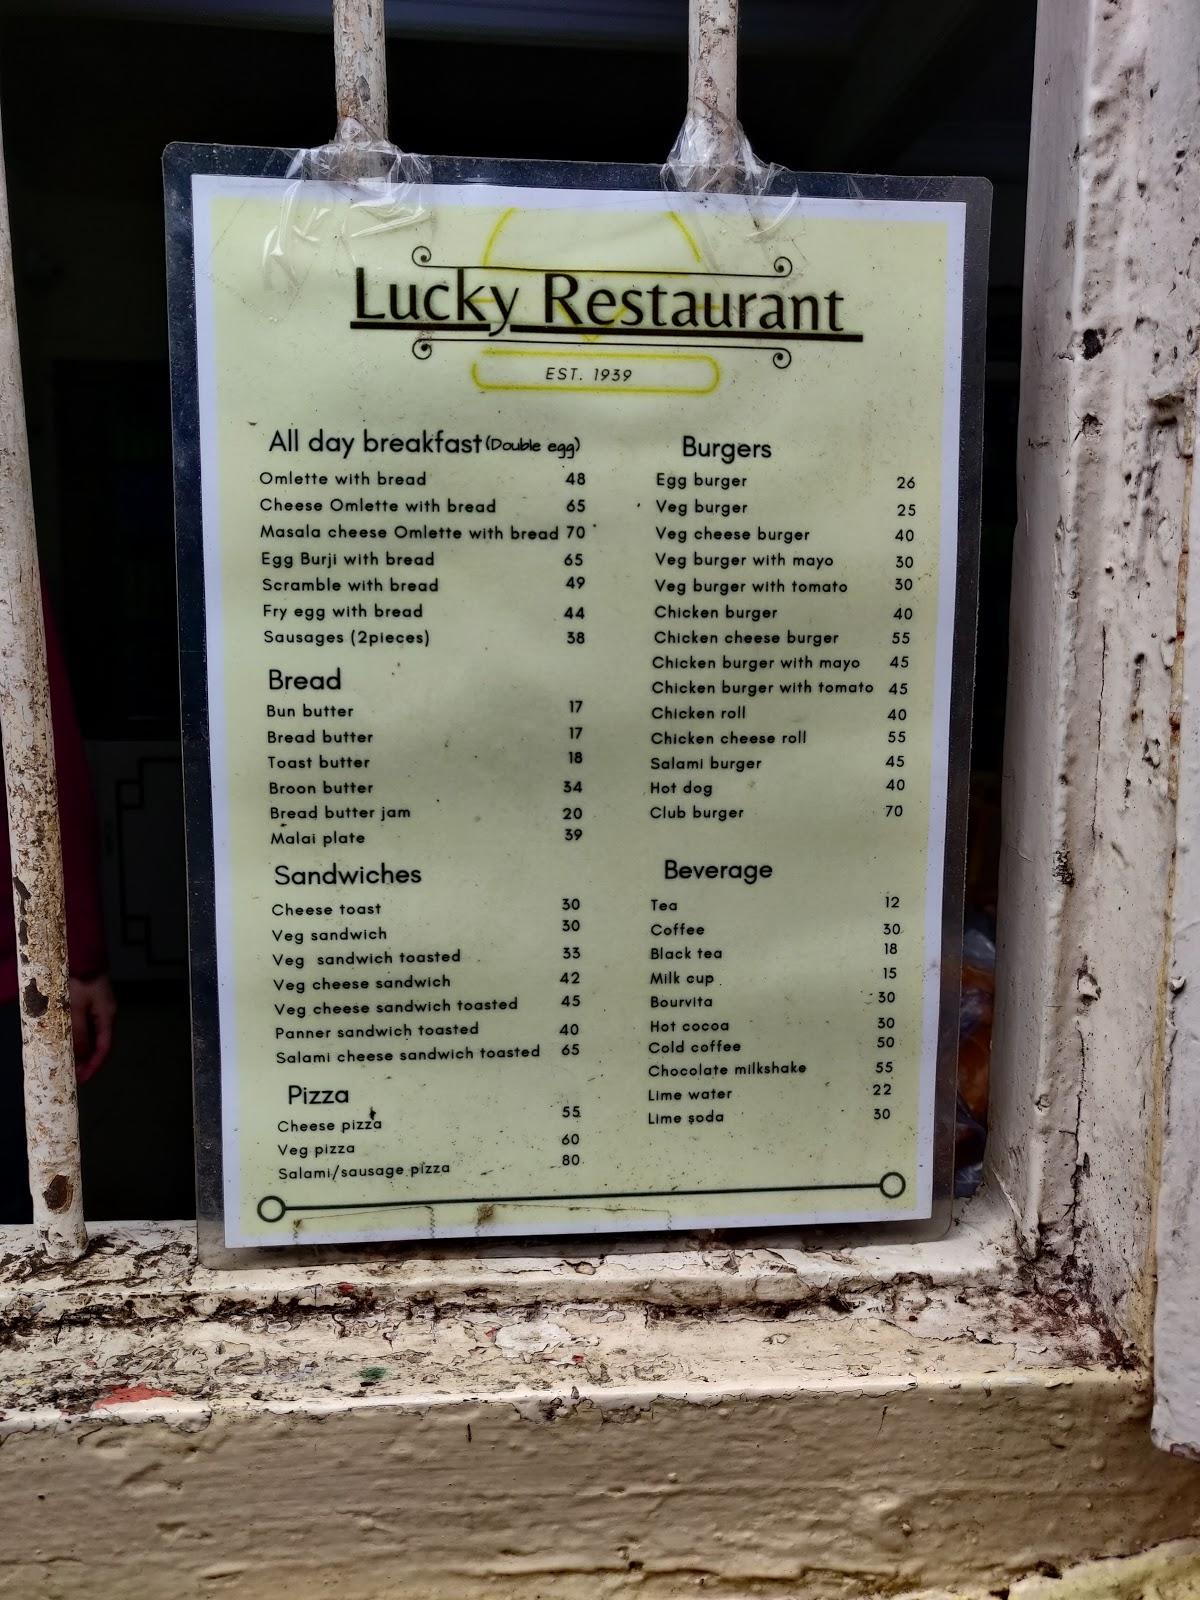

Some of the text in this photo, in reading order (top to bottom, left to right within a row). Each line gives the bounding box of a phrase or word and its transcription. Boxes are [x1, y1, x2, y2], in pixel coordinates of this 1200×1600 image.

[355, 266, 846, 336] Lucky Restaurant
[545, 367, 633, 382] EST. 1939
[268, 427, 581, 460] All day breakfast (Double egg)
[682, 434, 773, 465] Burgers
[259, 470, 586, 487] Omlette with bread 48
[655, 471, 916, 491] Egg burger 26
[655, 498, 917, 518] Veg burger 25
[260, 523, 586, 541] Masala cheese Omlette with bread 70
[655, 525, 915, 545] Veg cheese burger 40
[261, 550, 584, 570] Egg Burji with bread 65
[654, 577, 913, 597] Veg burger with tomato 30
[263, 602, 586, 622] Fry egg with bread 44
[654, 603, 913, 623] Chicken burger 40
[263, 628, 586, 648] Sausages (2pieces) 38
[651, 654, 910, 673] Chicken burger with mayo 45
[268, 666, 342, 691] Bread
[651, 679, 908, 698] Chicken burger with tomato 45
[266, 699, 584, 718] Bun butter 17
[650, 705, 907, 721] Chicken roll 40
[267, 726, 584, 744] Bread butter 17
[650, 729, 906, 745] Chicken cheese roll 55
[267, 751, 584, 769] Toast butter 18
[650, 755, 905, 773] Salami burger 45
[268, 780, 583, 795] Broon butter 34
[649, 778, 906, 798] Hot dog 40
[270, 804, 583, 822] Bread butter jam 20
[649, 804, 904, 823] Club burger 70
[270, 827, 583, 848] Malai plate 39
[274, 861, 423, 886] Sandwiches
[664, 858, 773, 886] Beverage
[271, 897, 581, 917] Cheese toast 30
[650, 895, 900, 912] Tea 12
[271, 919, 581, 945] Veg sandwich 30
[650, 922, 901, 937] Coffee 30
[272, 946, 581, 970] Veg sandwich toasted 33
[649, 942, 898, 961] Black tea 18
[649, 966, 897, 988] Milk cup 15
[273, 994, 581, 1019] Veg cheese sandwich toasted 45
[650, 991, 896, 1009] Bourvita 30
[650, 1016, 896, 1033] Hot cocoa 30
[276, 1043, 580, 1065] Salami cheese sandwich toasted 65
[648, 1036, 895, 1055] Cold coffee 50
[647, 1060, 894, 1078] Chocolate milkshake 55
[288, 1084, 350, 1105] Pizza
[648, 1082, 892, 1102] Lime water 22
[277, 1133, 580, 1160] Veg pizza 60
[278, 1153, 581, 1181] Salami/sausage pizza 80
